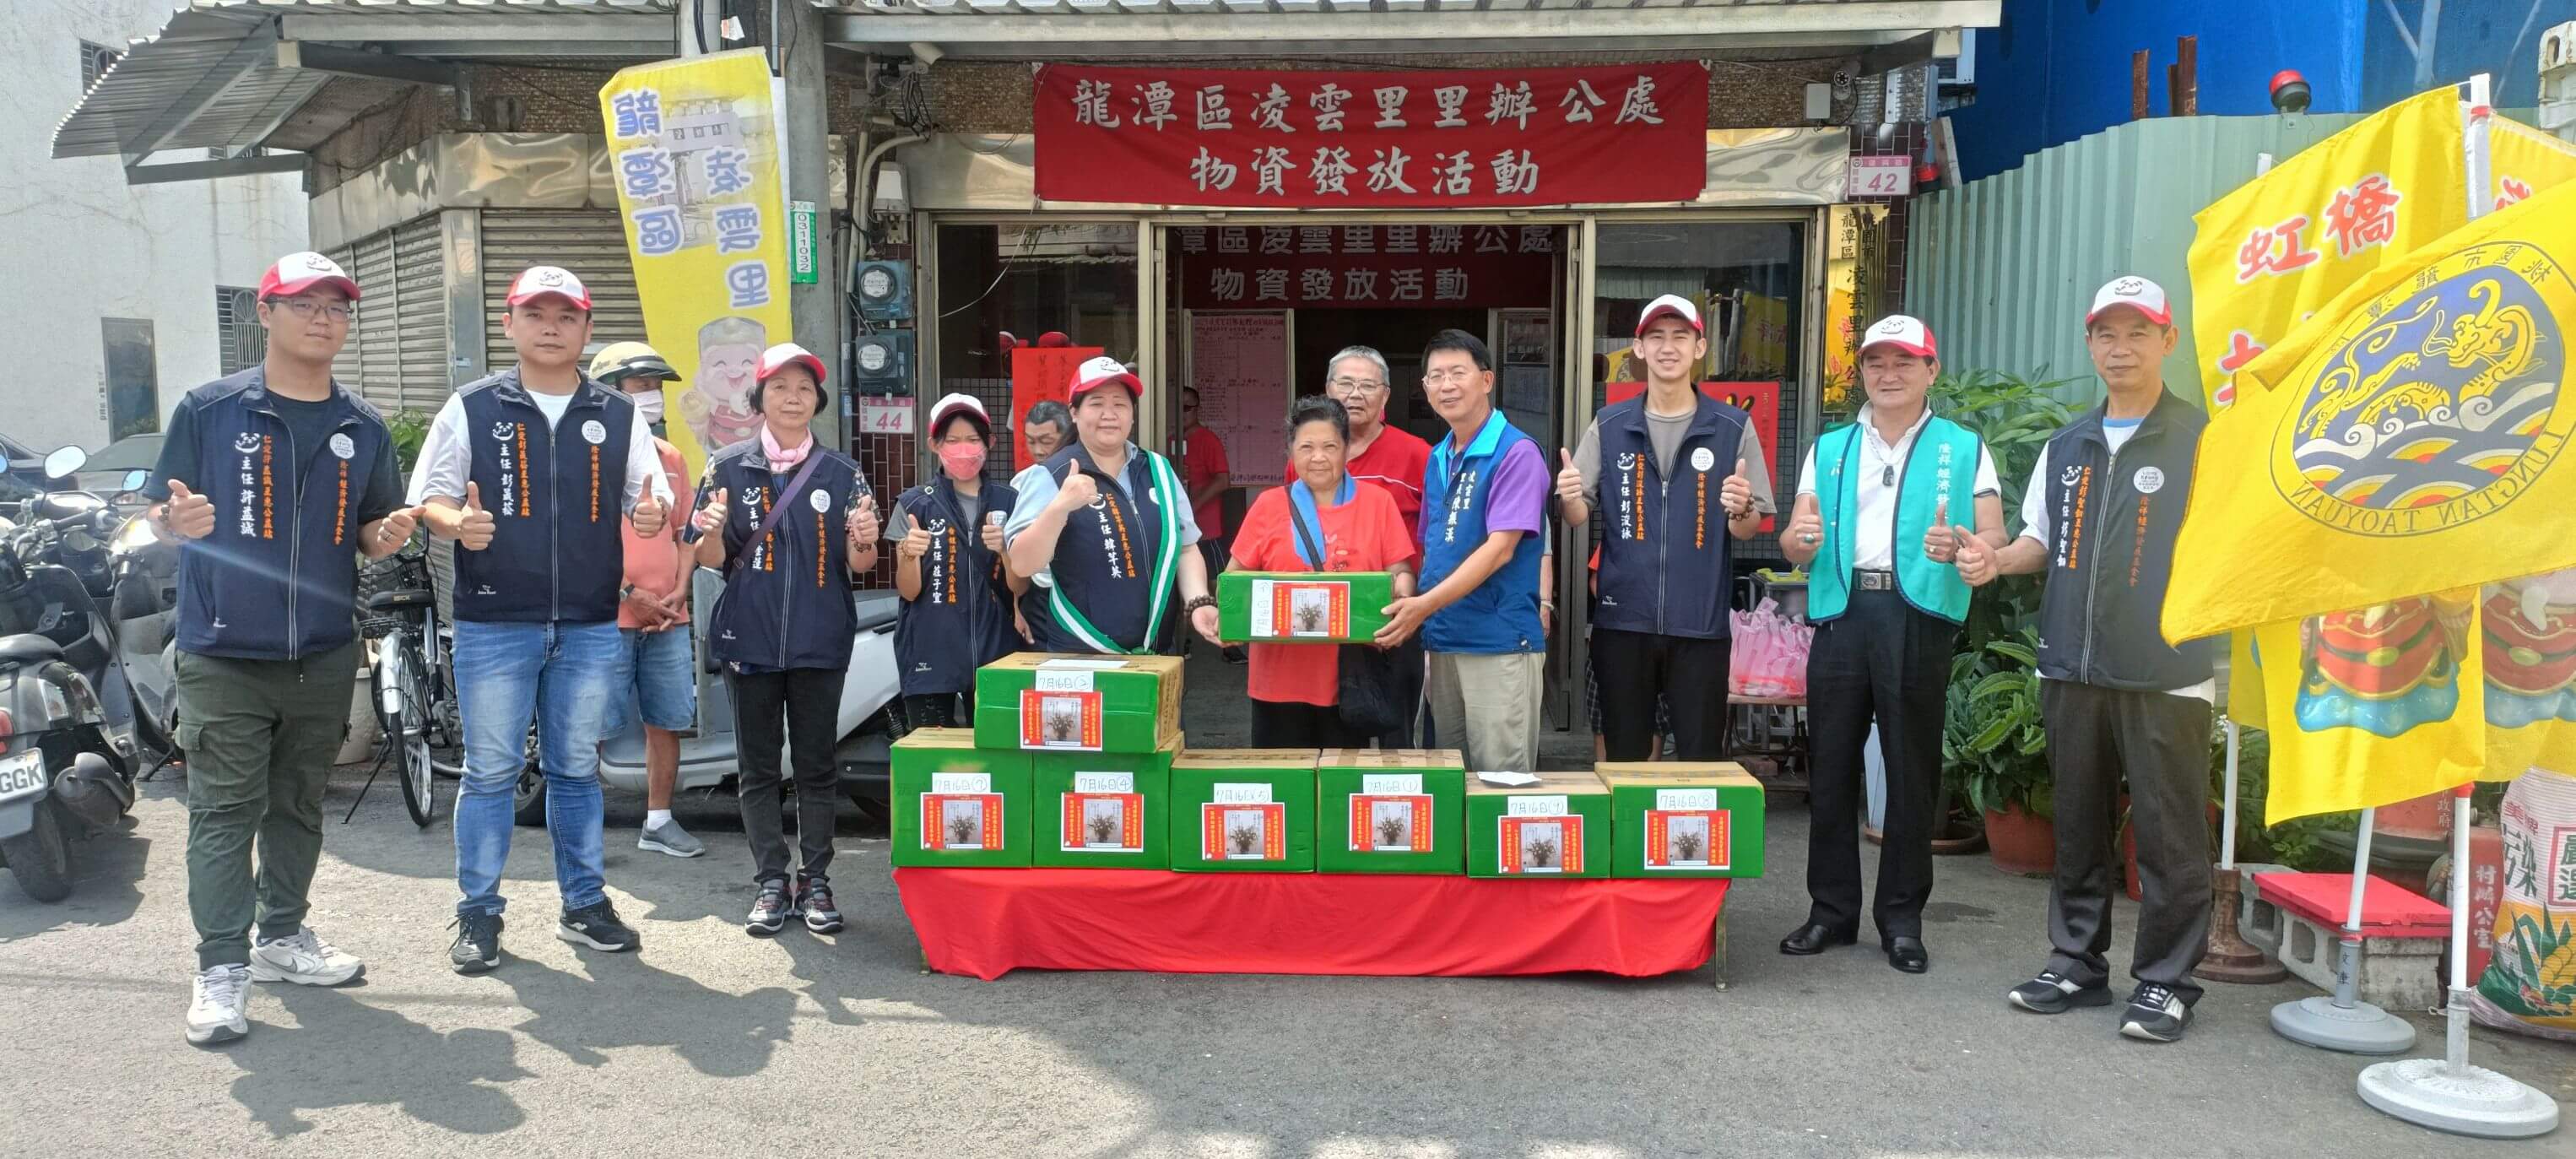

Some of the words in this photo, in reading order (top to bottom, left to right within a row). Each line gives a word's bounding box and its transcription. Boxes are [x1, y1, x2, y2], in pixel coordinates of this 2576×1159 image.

[1072, 75, 1664, 132] 龍潭區凌雲里里辦公處
[1189, 146, 1540, 196] 物資發放活動
[1867, 172, 1898, 192] 42
[798, 214, 810, 271] 0311032
[1840, 213, 1856, 259] 龍潭區
[2238, 175, 2402, 281] 虹橋
[1210, 267, 1469, 302] 物資發放活動
[875, 411, 902, 431] 44
